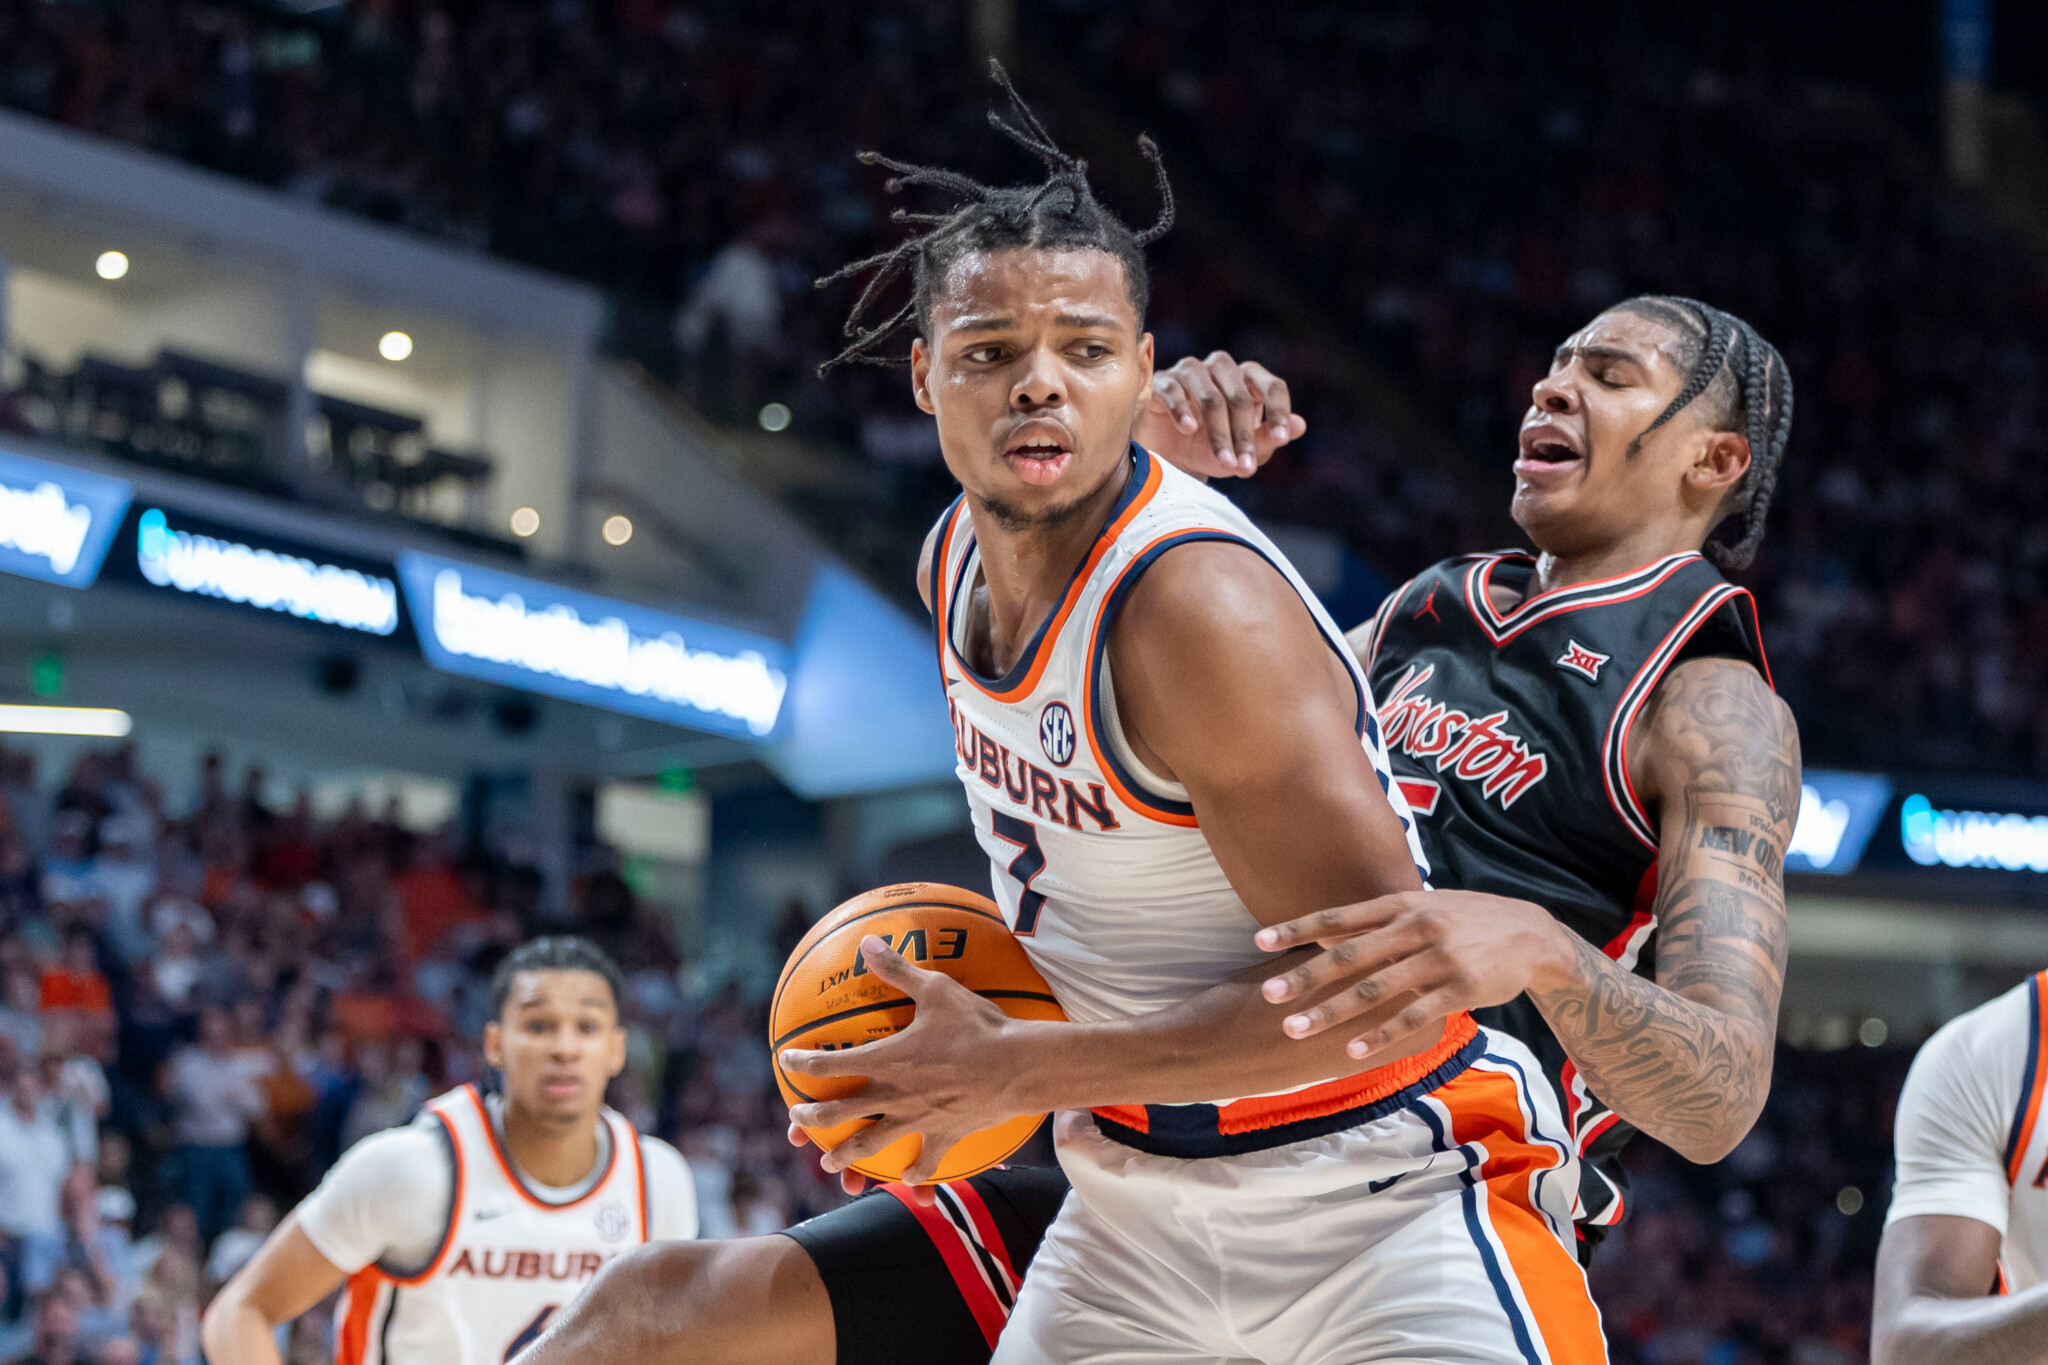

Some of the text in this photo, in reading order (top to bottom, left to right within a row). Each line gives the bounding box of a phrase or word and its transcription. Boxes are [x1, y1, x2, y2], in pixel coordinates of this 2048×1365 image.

[1563, 645, 1603, 675] XII
[1041, 705, 1074, 763] SEC
[991, 807, 1047, 937] 7
[817, 968, 850, 995] NXT
[866, 1026, 891, 1034] BALL
[448, 1247, 616, 1280] AUBUR
